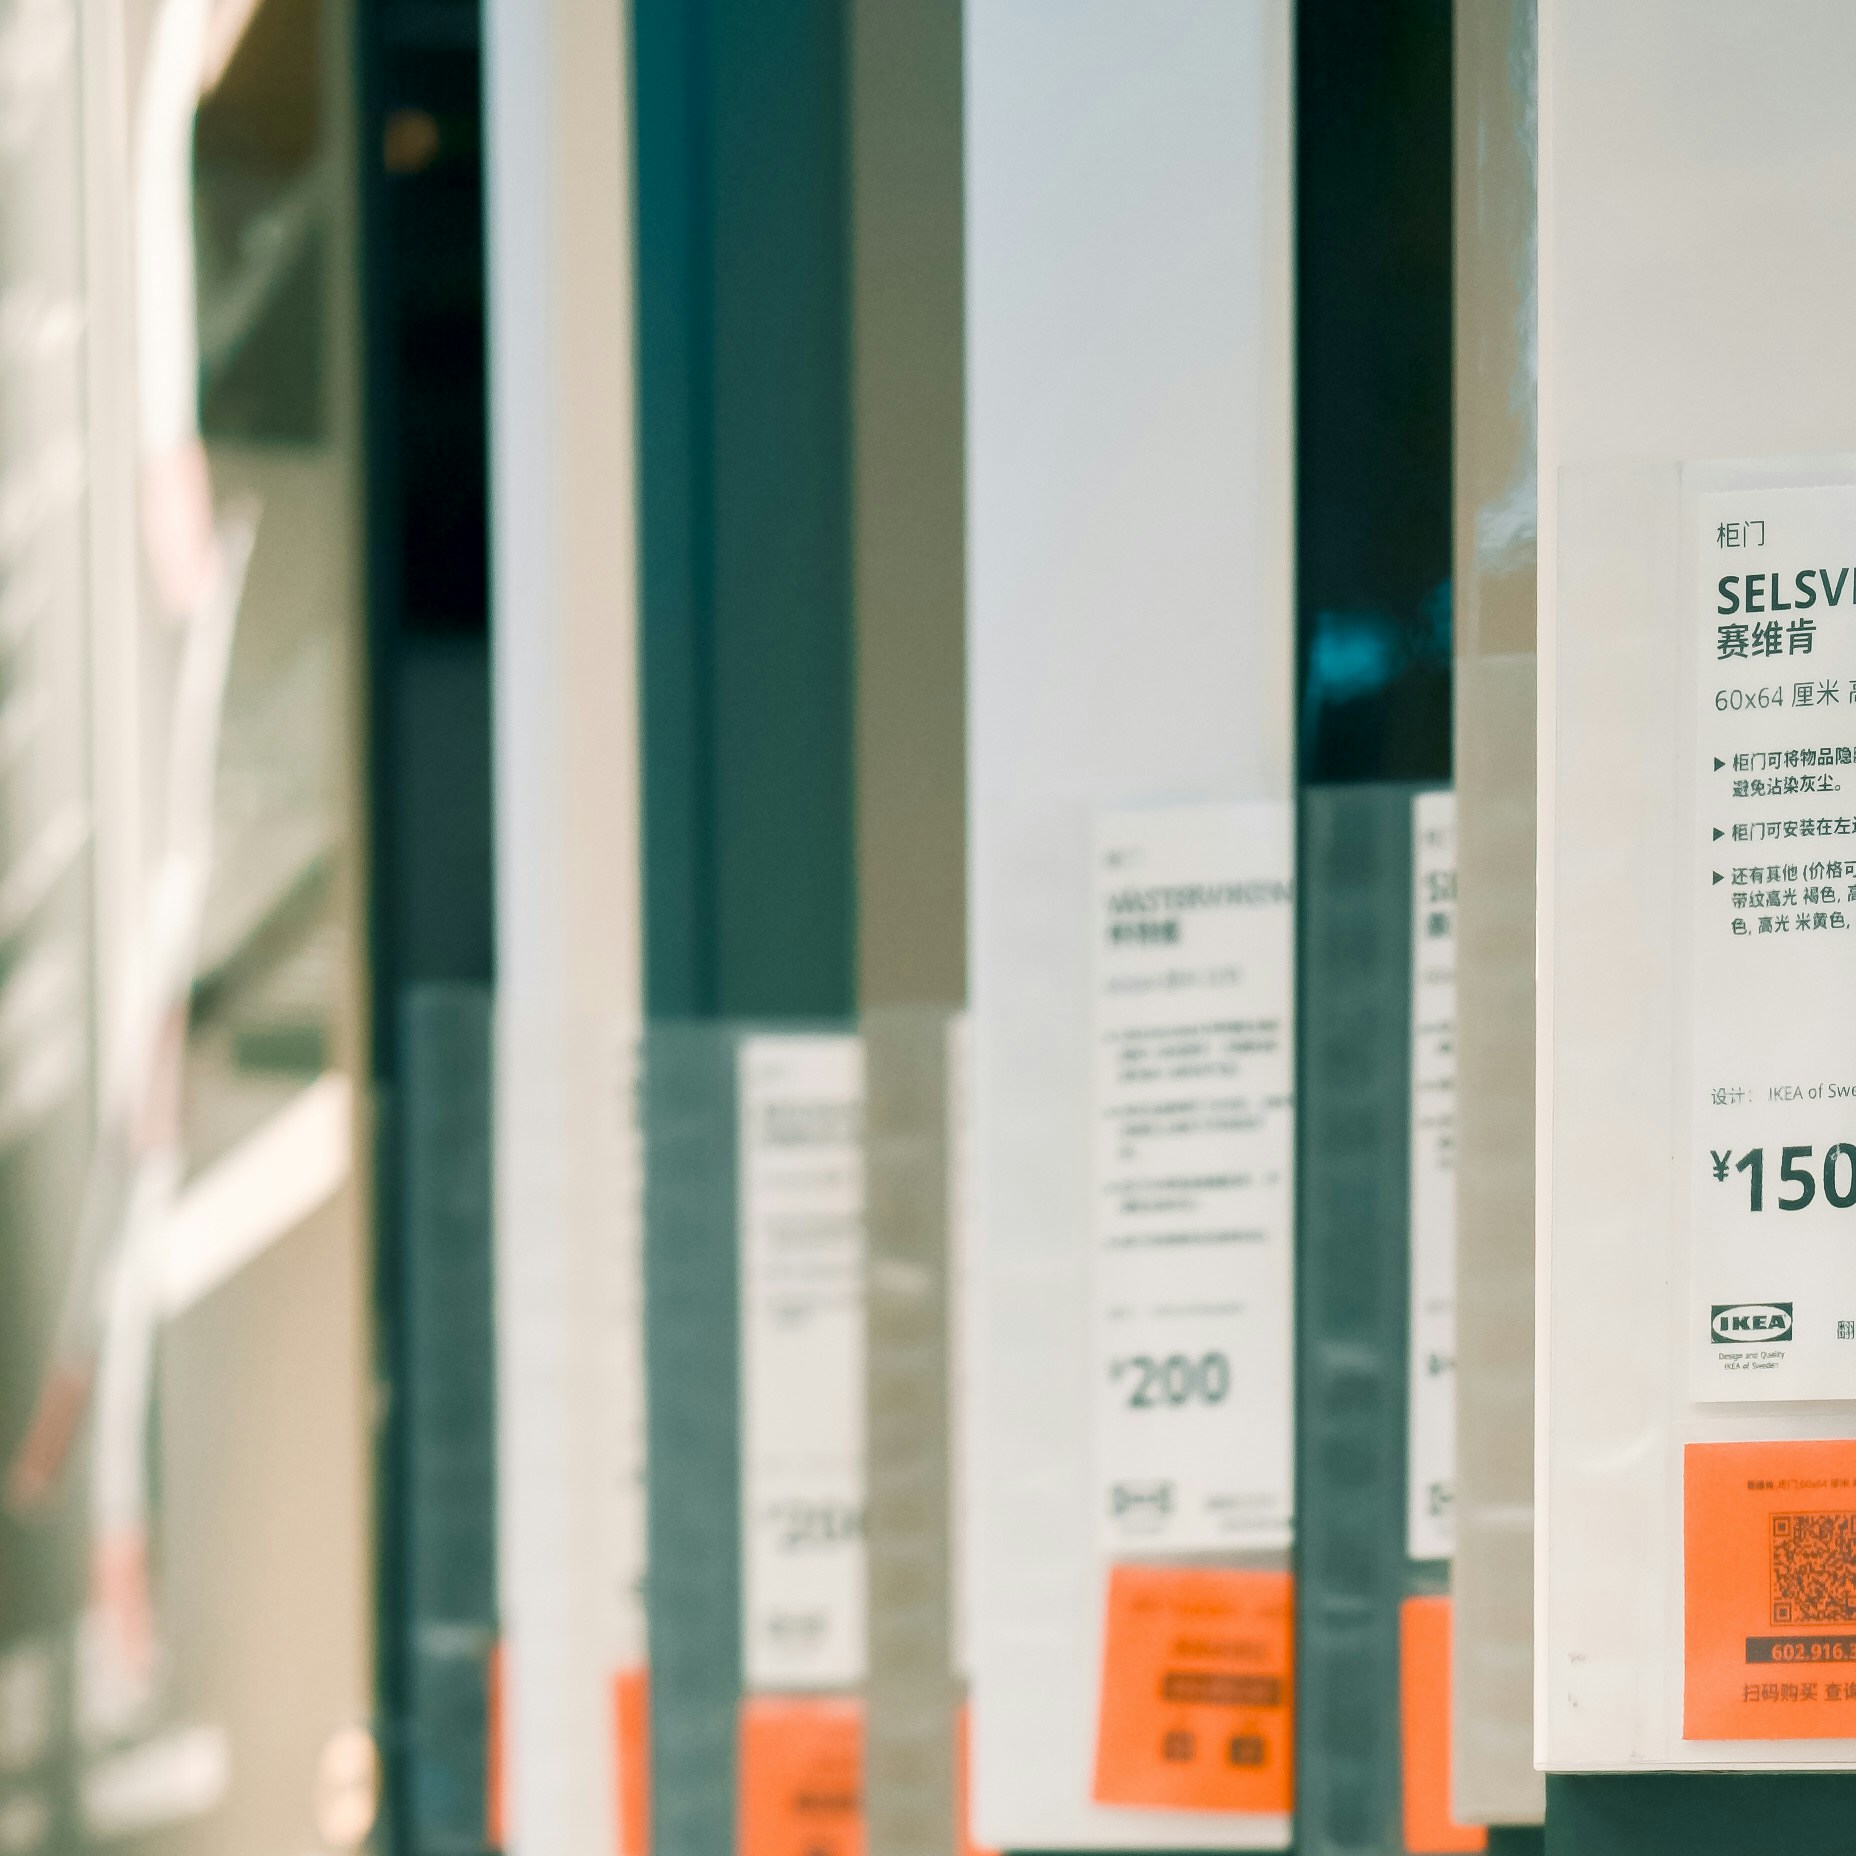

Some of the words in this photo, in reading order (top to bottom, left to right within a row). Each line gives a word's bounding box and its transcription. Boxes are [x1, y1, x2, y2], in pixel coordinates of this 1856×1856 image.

[1716, 520, 1765, 548] 柜门
[1717, 618, 1817, 660] 赛维肯
[1715, 686, 1783, 711] 60x64
[1792, 679, 1840, 706] 厘米
[1732, 773, 1841, 797] 避免沾染灰尘。
[1731, 863, 1798, 885] 还有其他
[1731, 887, 1798, 909] 带纹高光
[1758, 913, 1790, 934] 高光
[1768, 1086, 1803, 1102] IKEA
[1808, 1083, 1823, 1099] of
[1719, 1314, 1787, 1332] IKEA
[1743, 1682, 1818, 1702] 扫码购买
